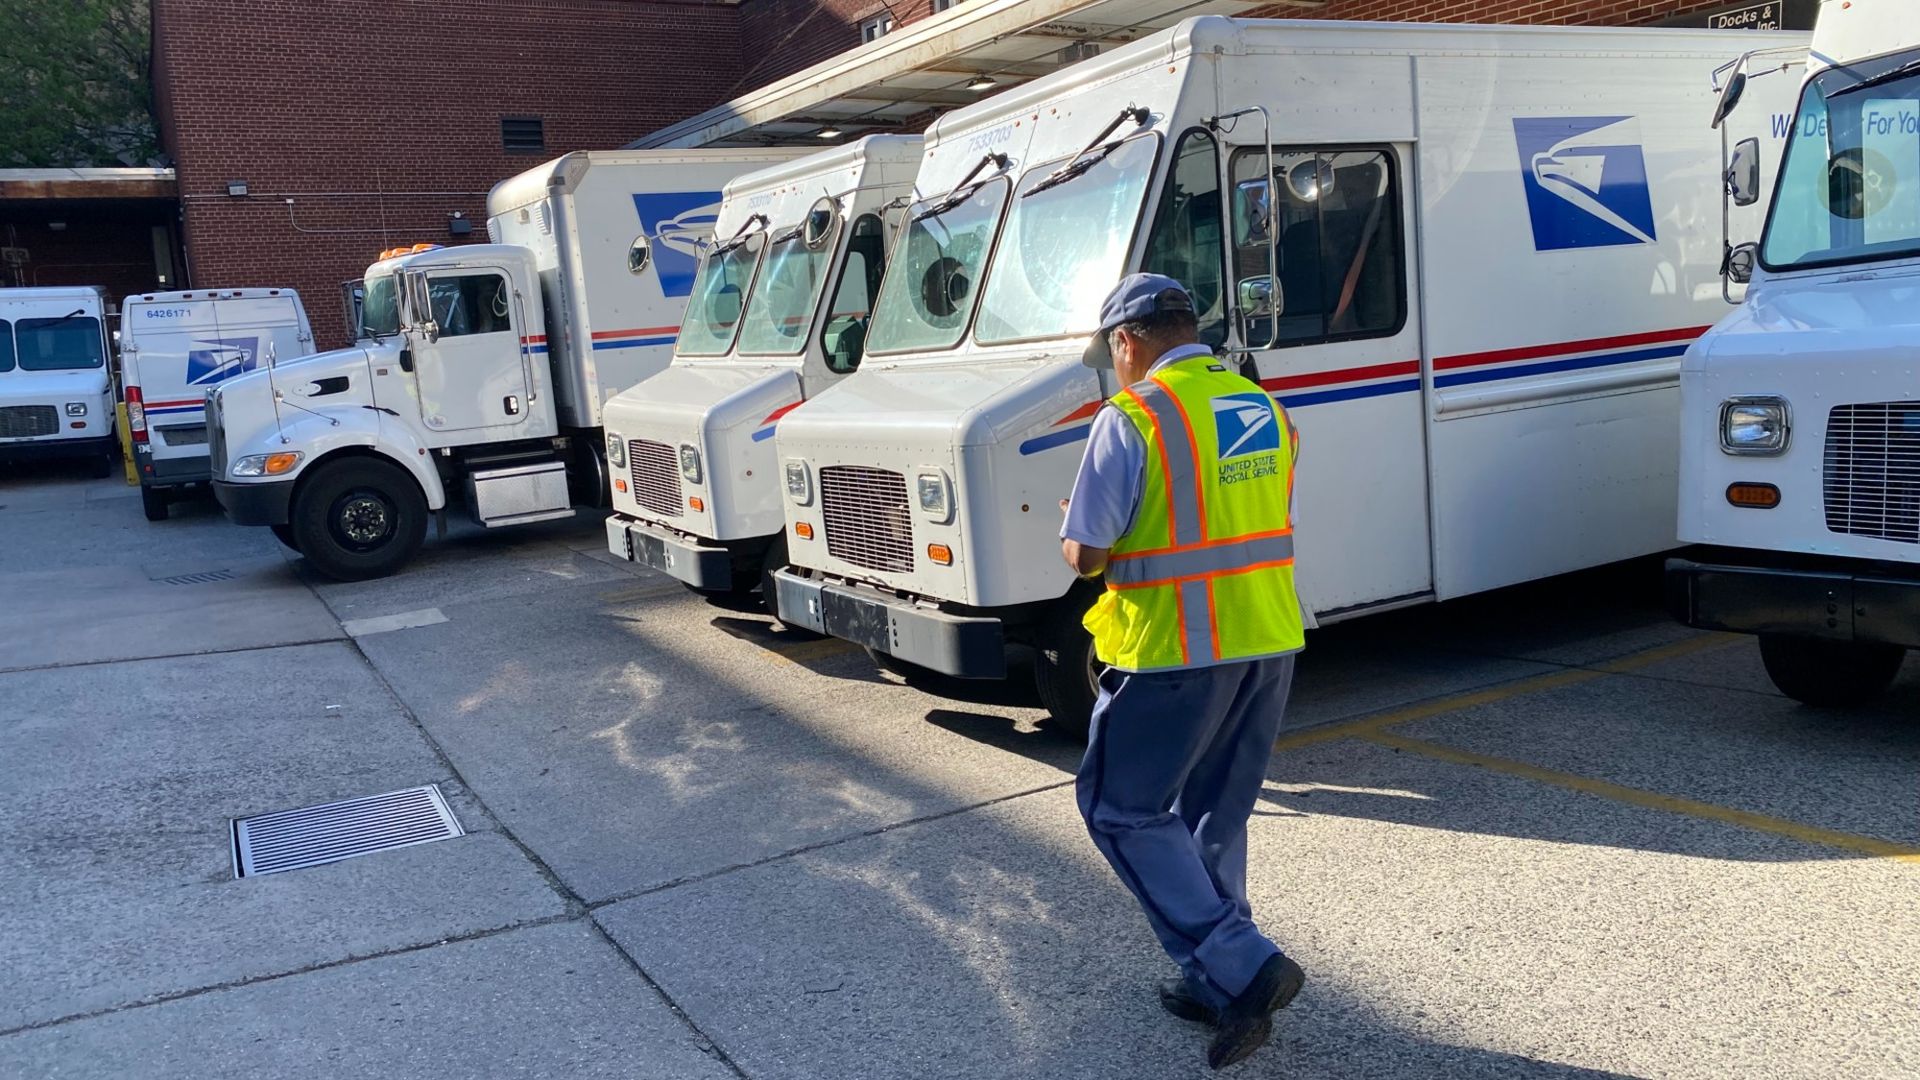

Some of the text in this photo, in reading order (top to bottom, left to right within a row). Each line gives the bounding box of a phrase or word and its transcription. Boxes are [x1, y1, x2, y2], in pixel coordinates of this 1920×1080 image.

[1718, 5, 1772, 28] Docks &
[1756, 21, 1778, 30] Inc.
[1867, 112, 1895, 136] For
[1898, 110, 1920, 135] Yo
[146, 309, 191, 318] 6426171
[1219, 459, 1251, 475] UNITED
[1219, 471, 1250, 487] POSTAL
